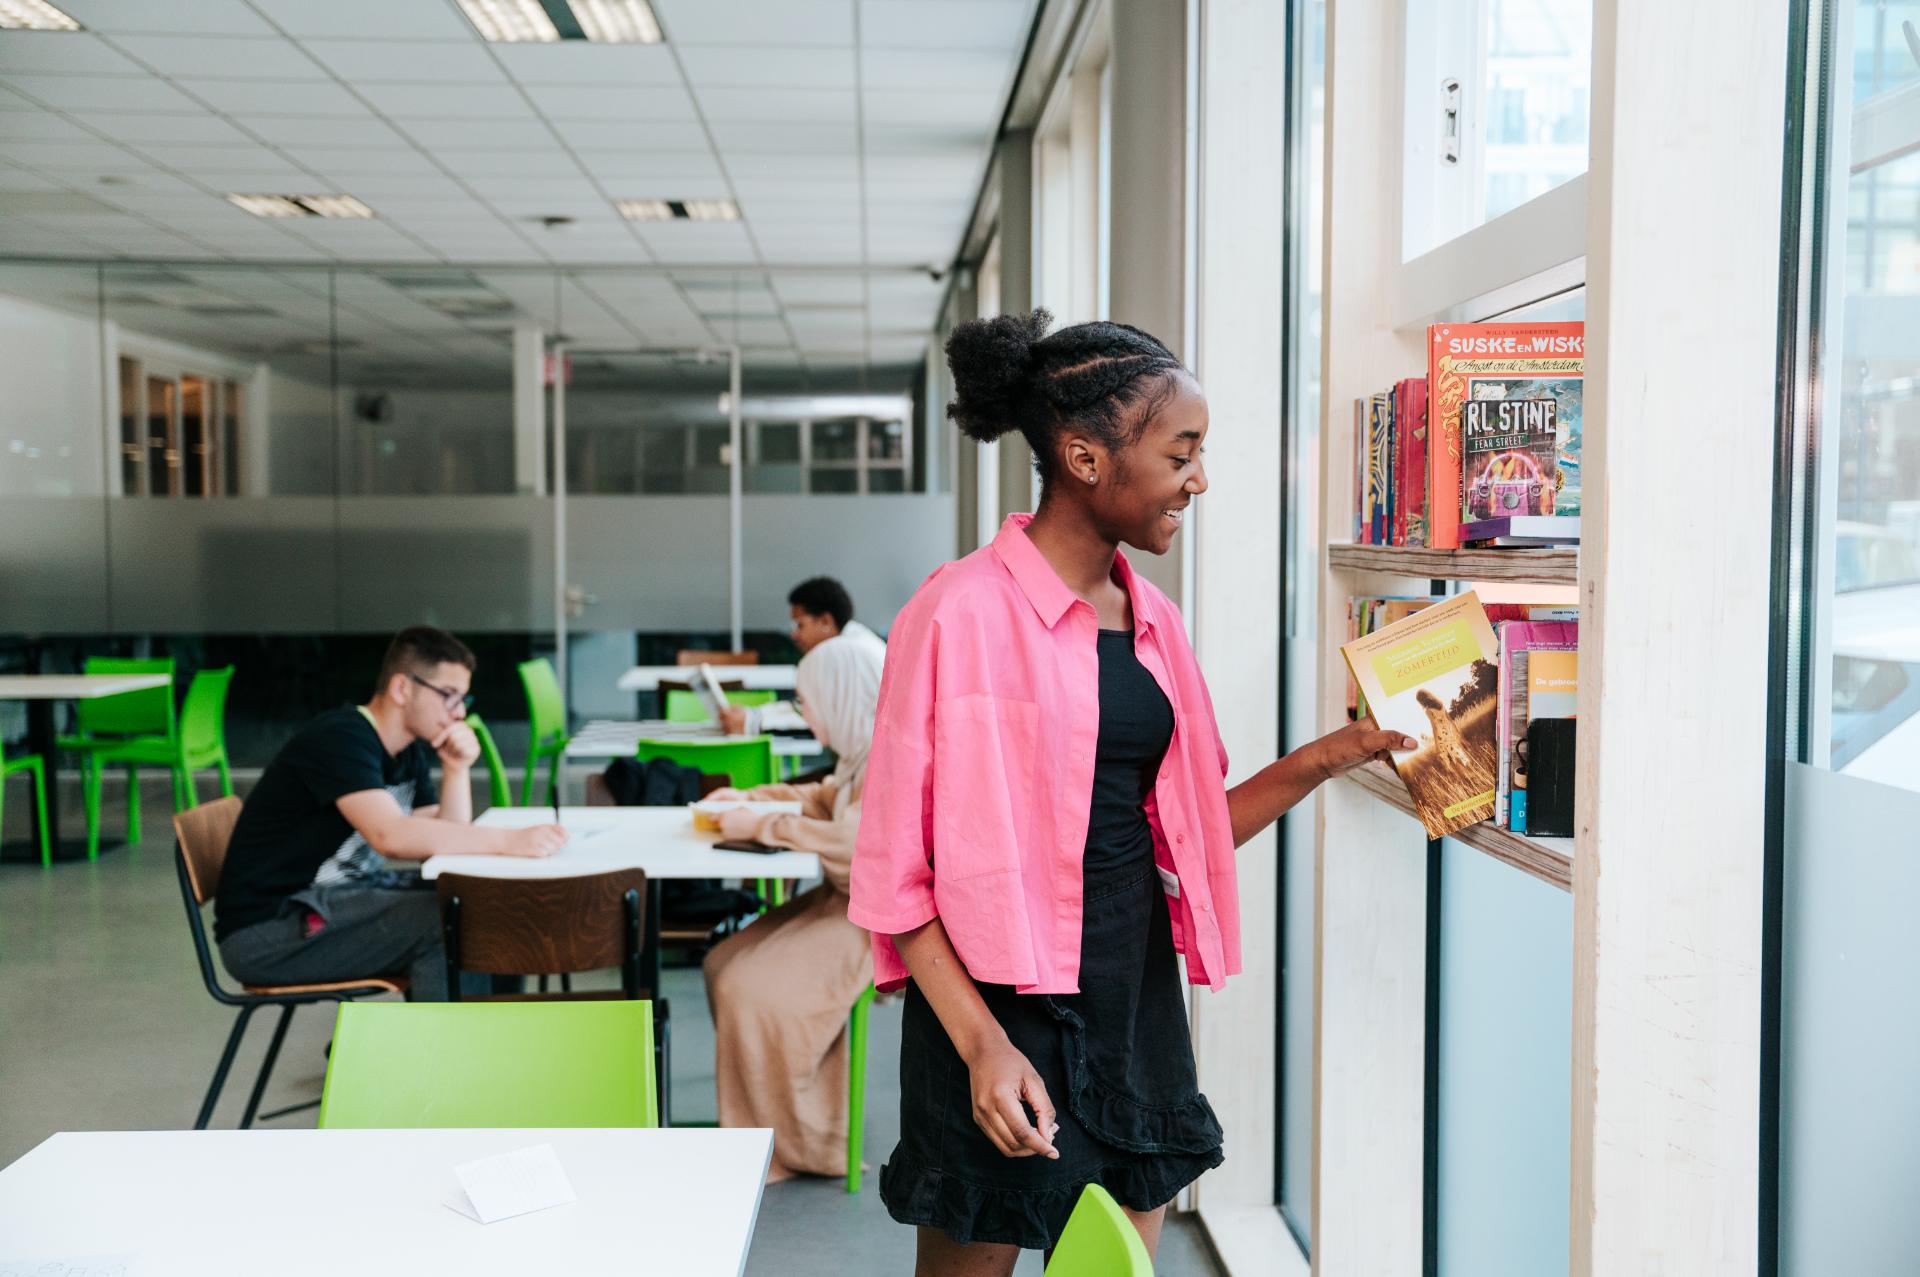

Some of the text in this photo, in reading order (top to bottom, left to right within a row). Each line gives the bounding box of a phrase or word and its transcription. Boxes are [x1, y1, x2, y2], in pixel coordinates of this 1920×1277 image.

[1449, 336, 1584, 353] SUSKE EN WISK
[1455, 359, 1492, 373] Angst
[1493, 362, 1505, 372] op
[1506, 360, 1518, 370] de
[1467, 400, 1556, 436] R.L. STINE
[1474, 439, 1493, 450] FEAR
[1536, 677, 1578, 687] De gebroe
